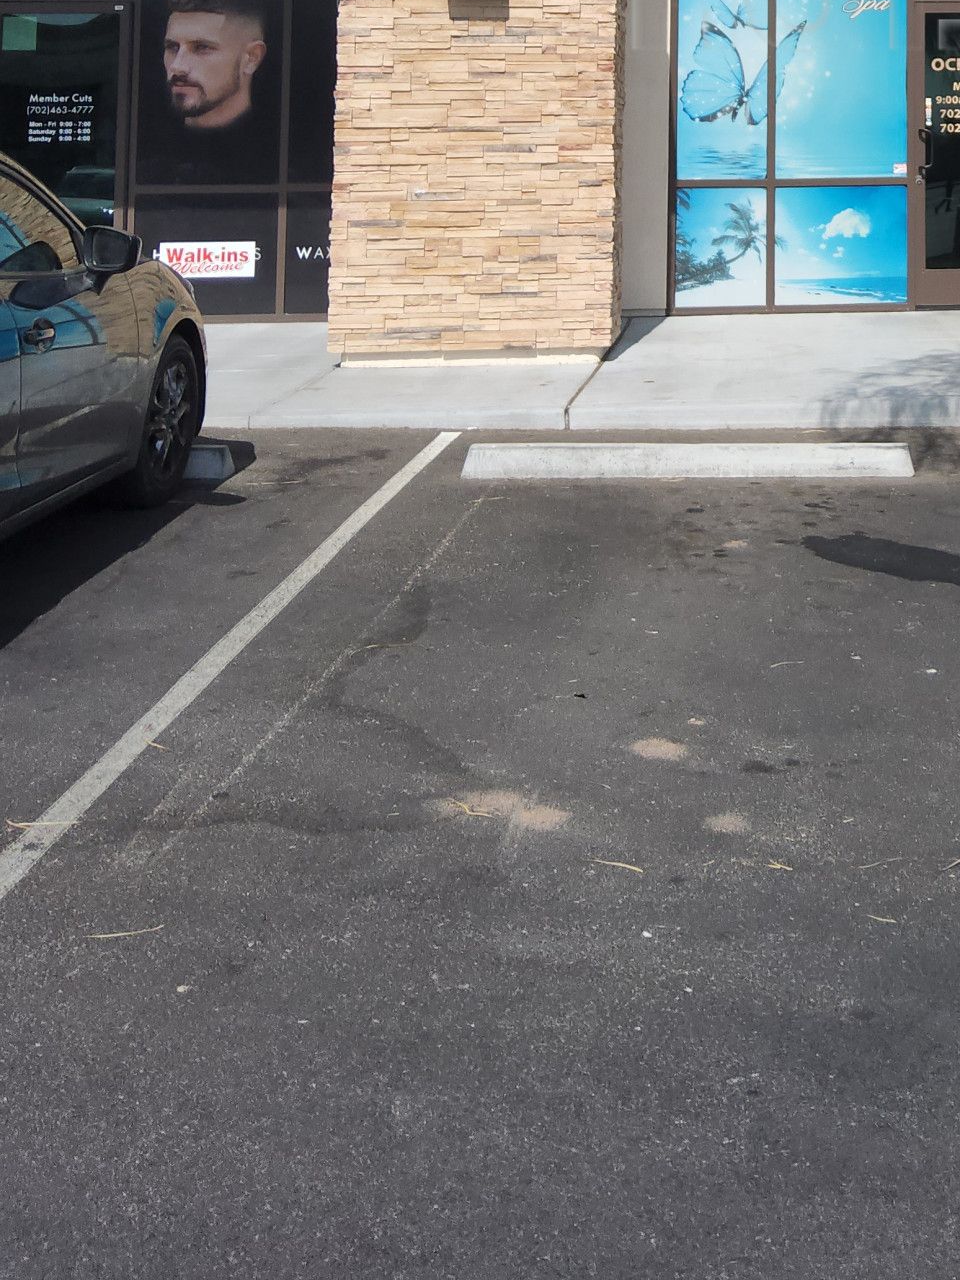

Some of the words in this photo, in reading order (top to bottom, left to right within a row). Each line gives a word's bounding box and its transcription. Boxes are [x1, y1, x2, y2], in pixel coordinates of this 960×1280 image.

[29, 92, 70, 103] Member
[71, 93, 93, 103] Cuts
[26, 105, 95, 116] (702)463-4777
[166, 247, 249, 263] Walk-ins
[171, 262, 244, 275] Welcome
